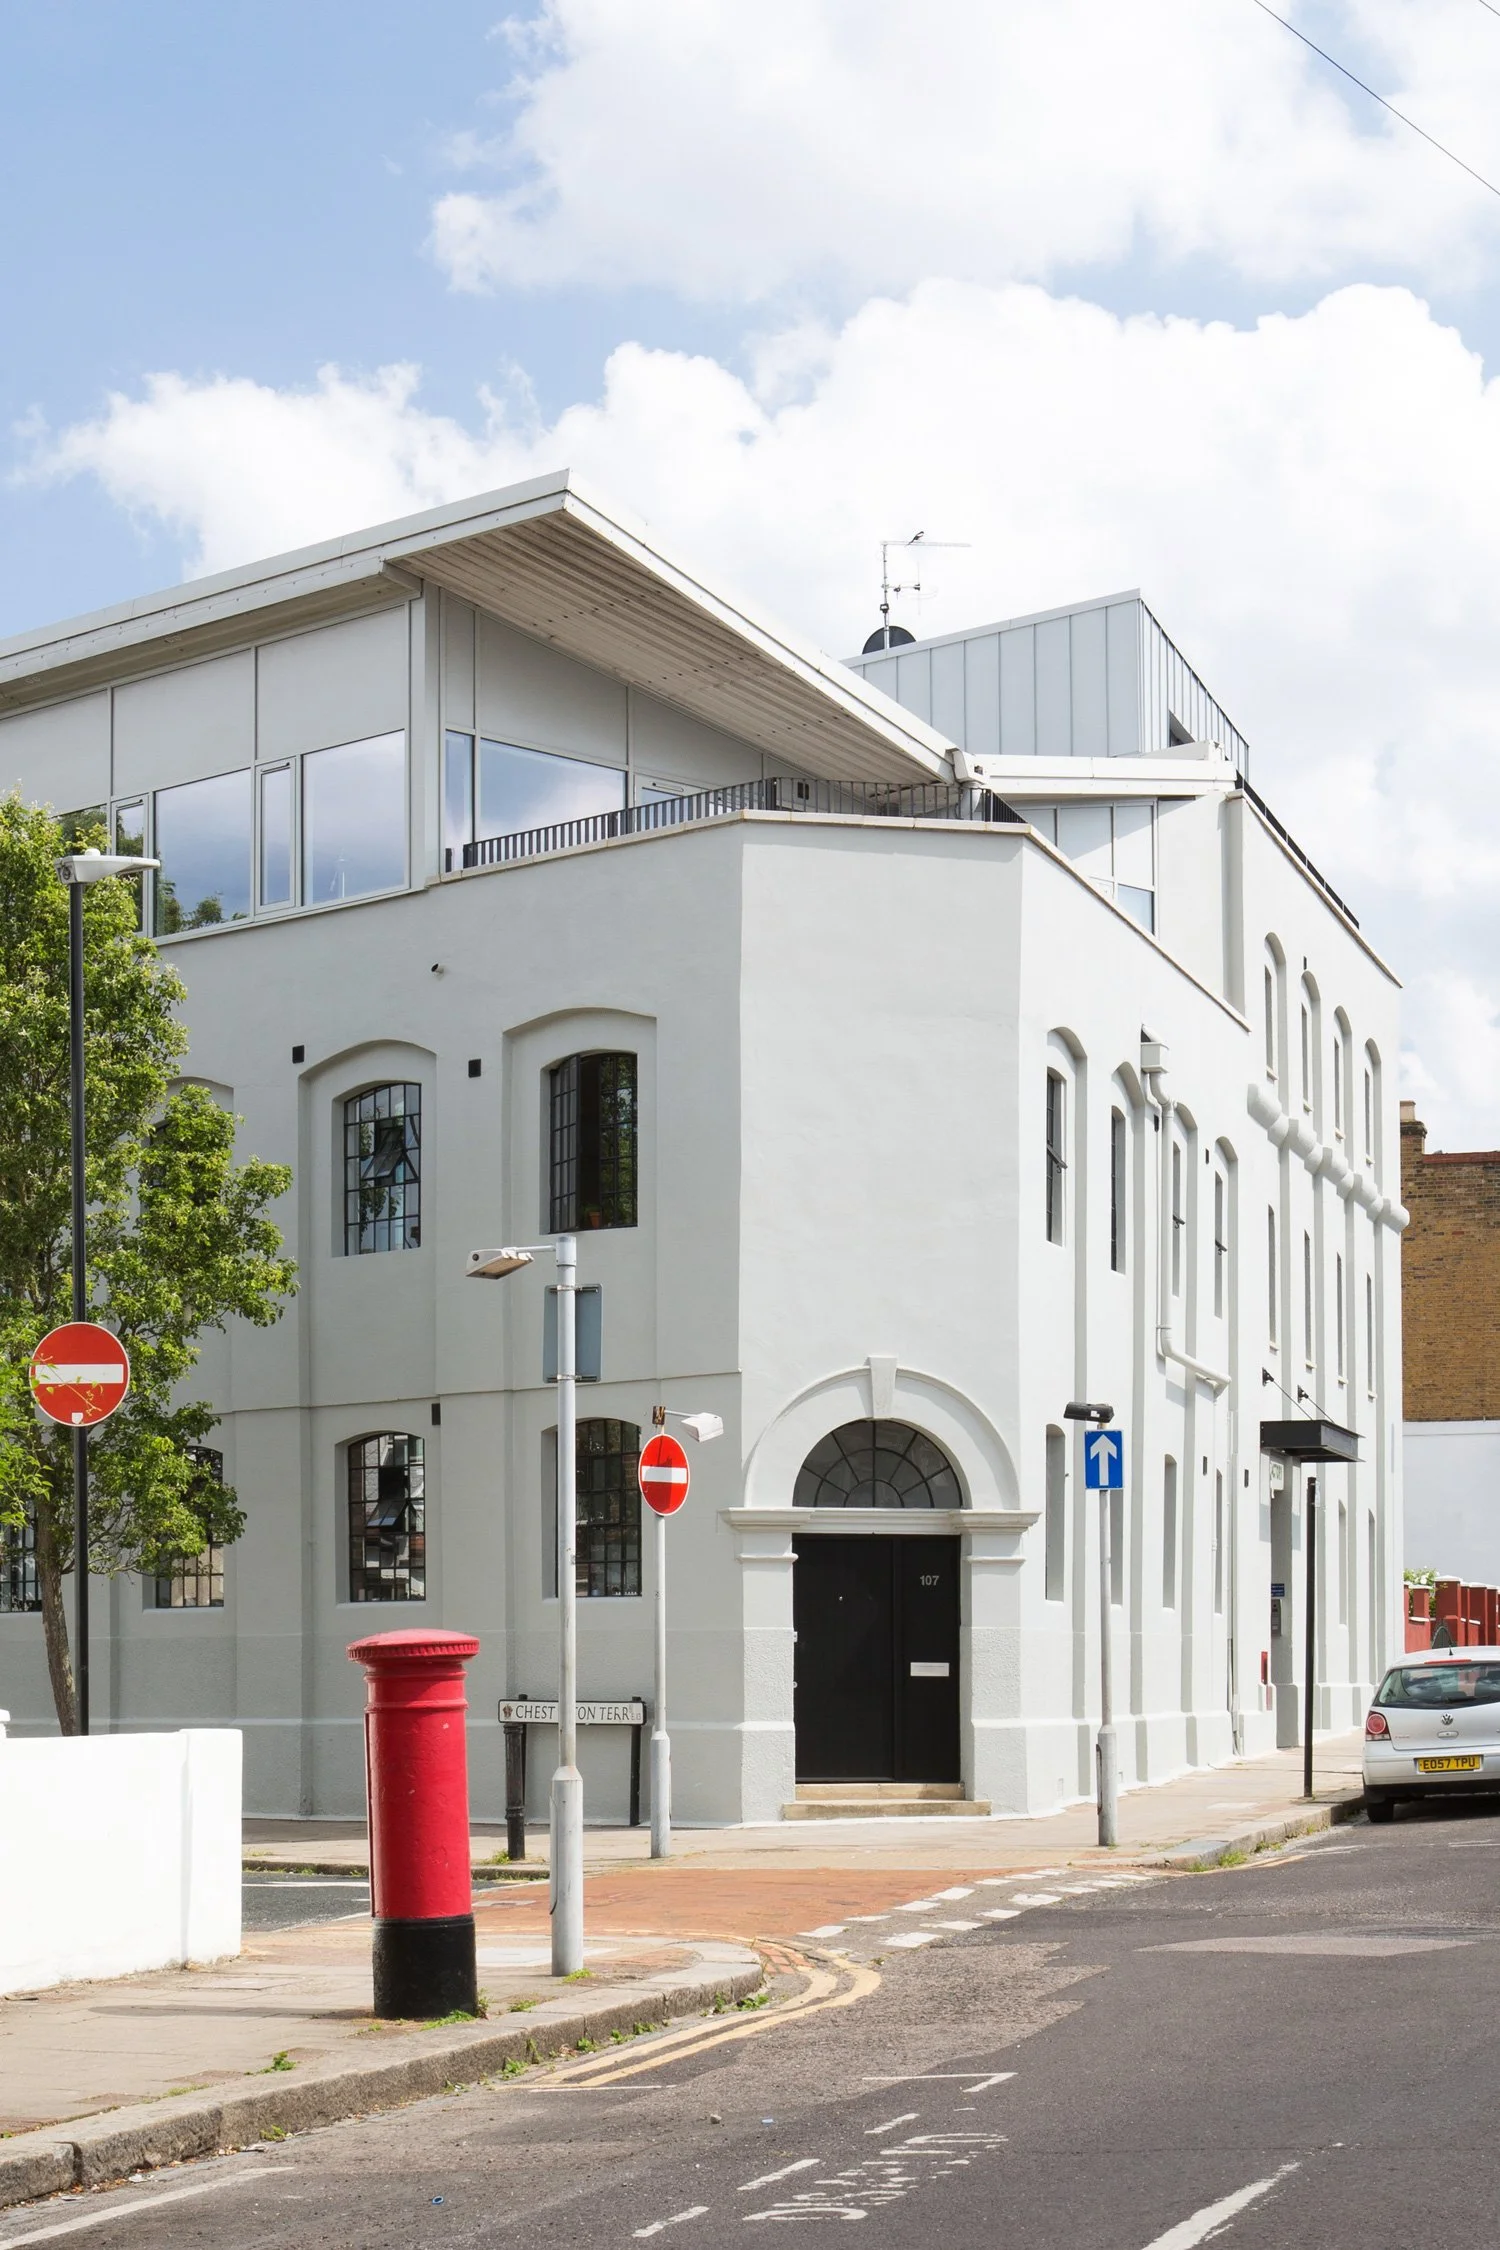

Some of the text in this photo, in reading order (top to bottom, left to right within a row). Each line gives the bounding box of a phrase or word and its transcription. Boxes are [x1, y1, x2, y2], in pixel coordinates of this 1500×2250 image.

[919, 1574, 940, 1586] 107
[600, 1706, 630, 1721] TERR
[1423, 1757, 1476, 1770] EO57 TPU
